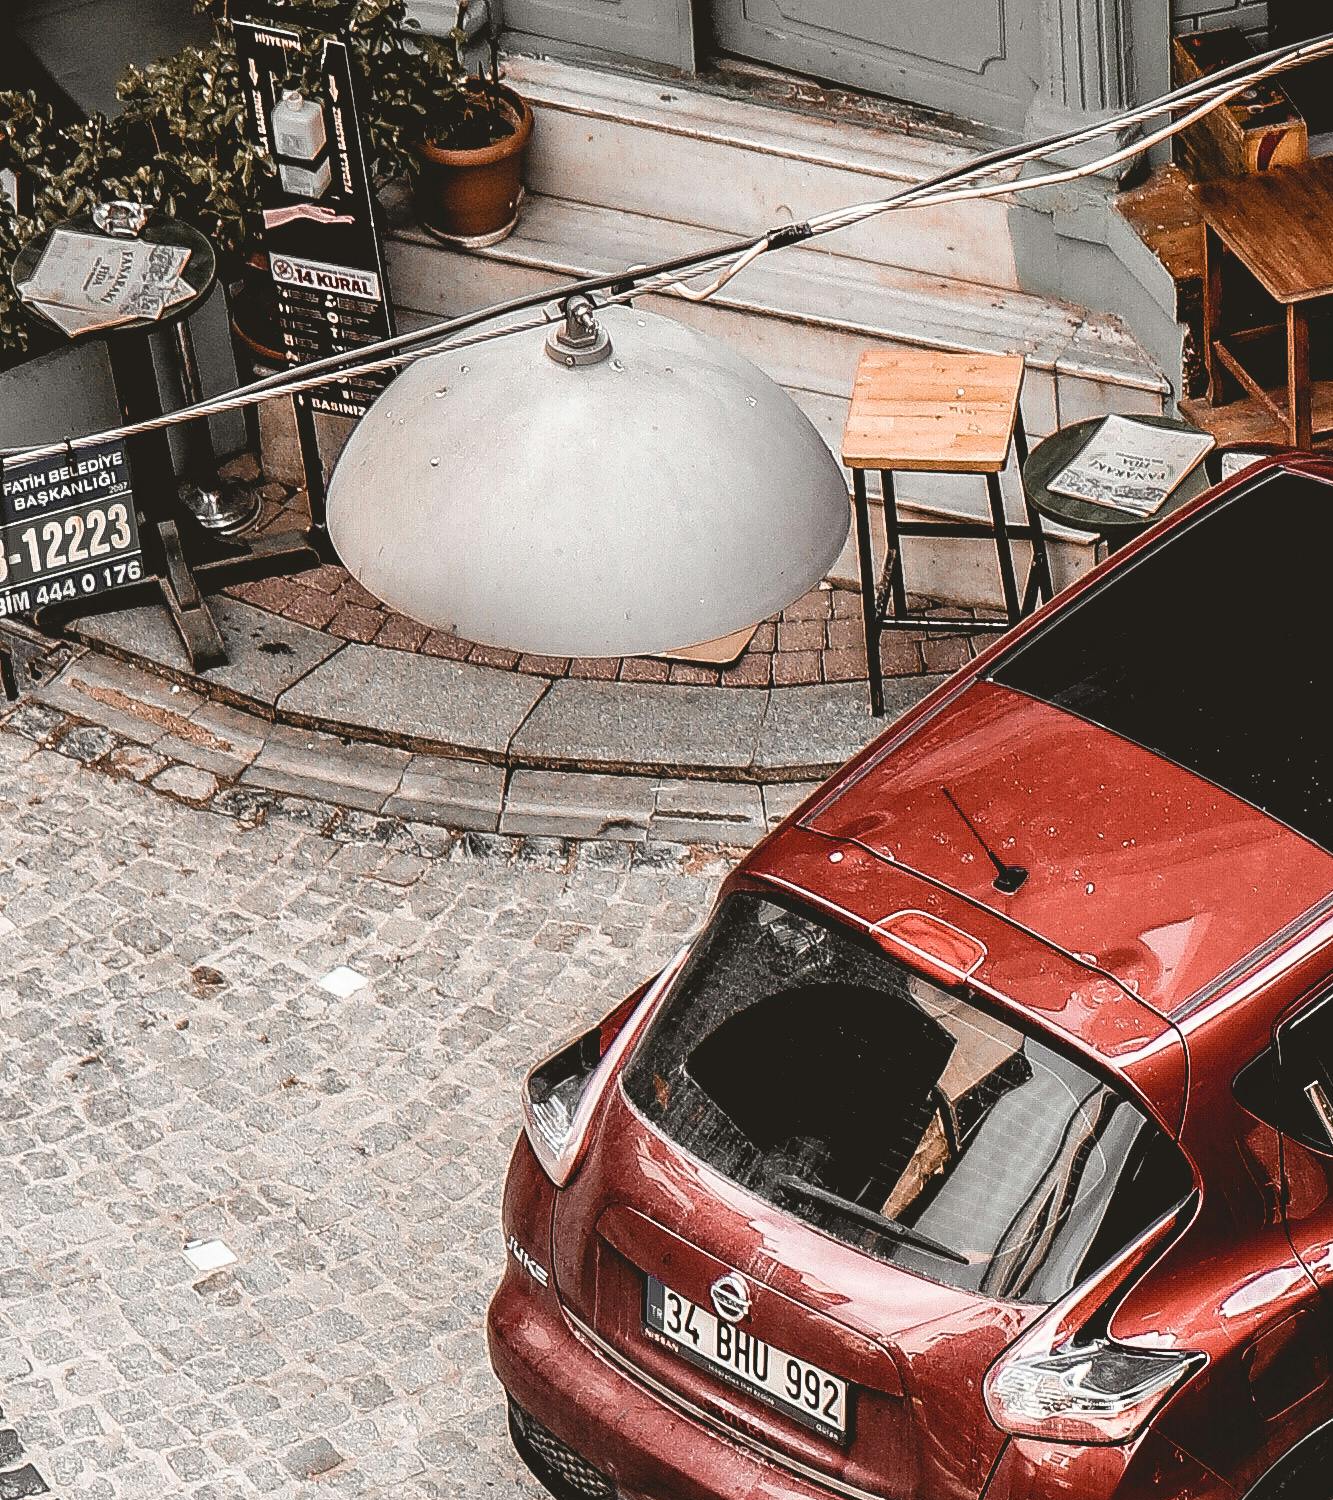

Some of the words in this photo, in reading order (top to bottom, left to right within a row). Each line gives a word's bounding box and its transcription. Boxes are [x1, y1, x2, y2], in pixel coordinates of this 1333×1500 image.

[295, 268, 314, 285] 14
[316, 272, 373, 297] KURAL
[3, 473, 46, 496] FATİH
[48, 452, 123, 483] BELEDİYE
[14, 471, 117, 511] BAŞKANLIĞI
[36, 578, 77, 605] 444
[82, 573, 96, 593] 0
[103, 559, 141, 587] 176
[666, 1292, 700, 1346] 34
[716, 1322, 769, 1382] BHU
[785, 1358, 840, 1422] 992
